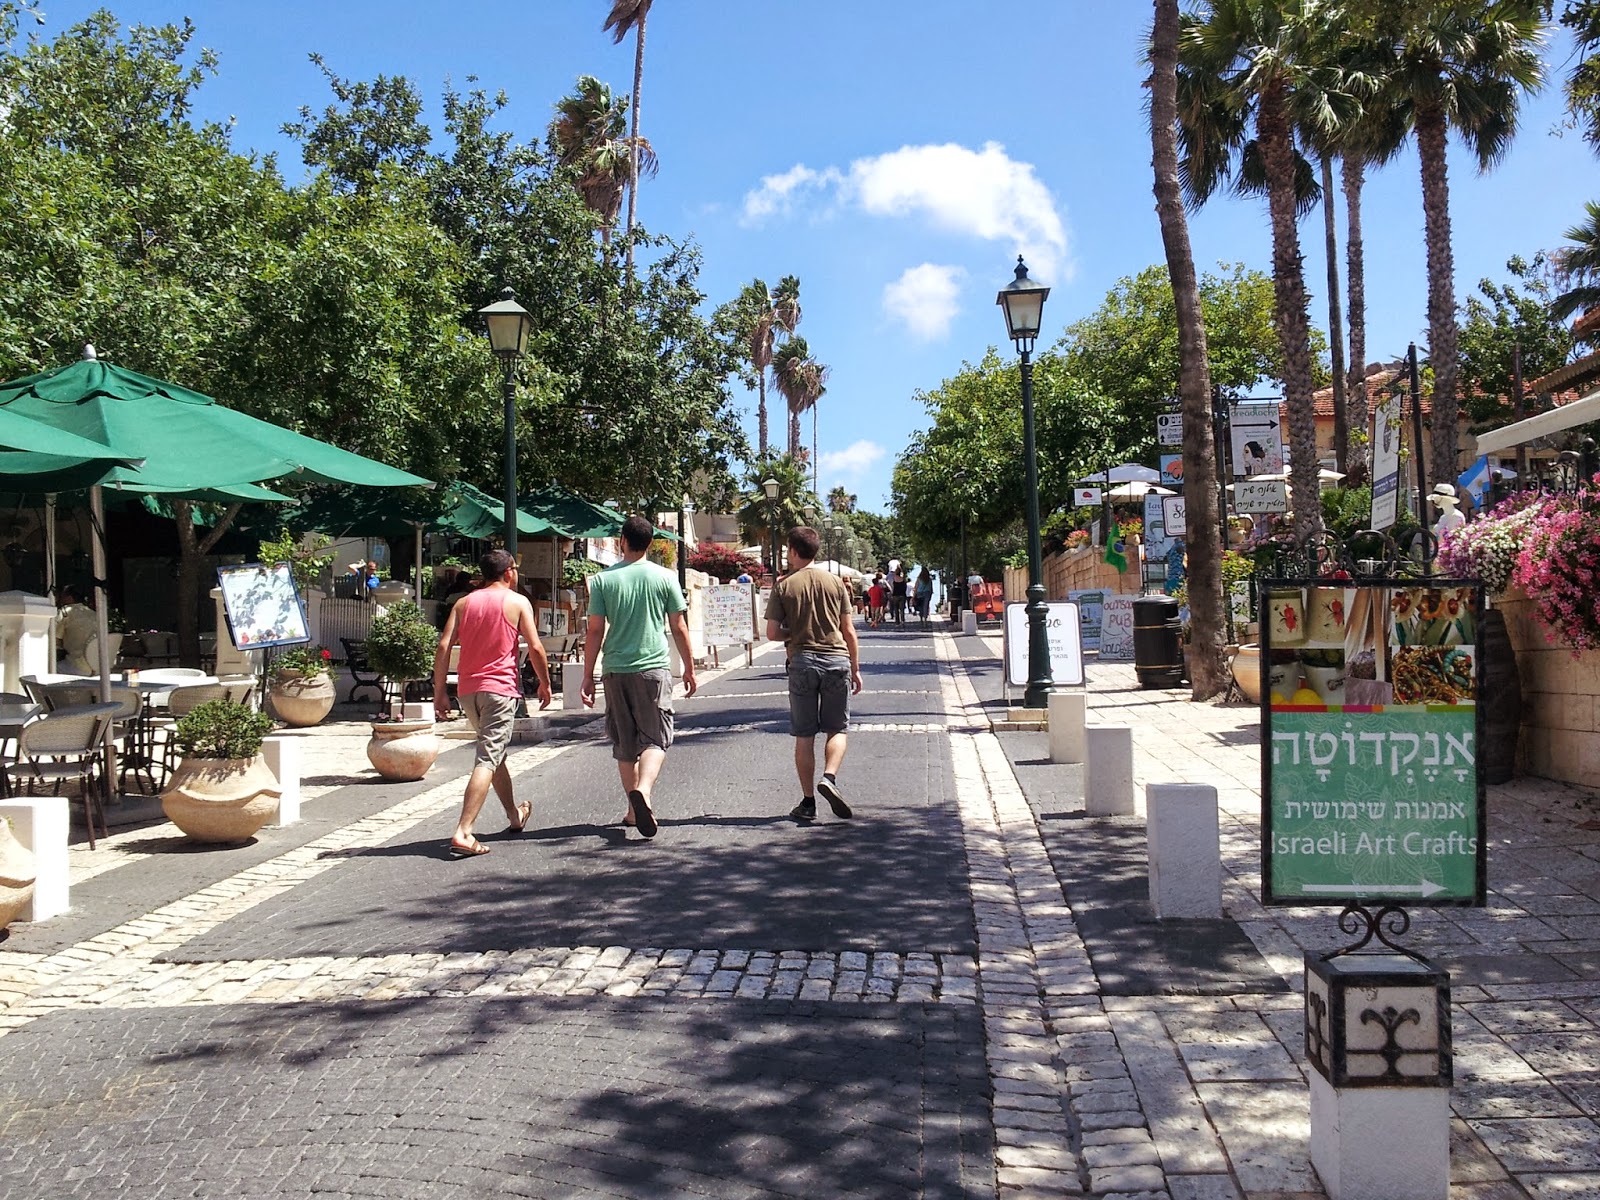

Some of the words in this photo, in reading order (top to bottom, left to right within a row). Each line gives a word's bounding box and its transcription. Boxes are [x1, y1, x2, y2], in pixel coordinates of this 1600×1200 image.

[1108, 613, 1131, 627] PUB
[1284, 800, 1387, 820] שימושית
[1394, 801, 1466, 820] אמנות
[1270, 831, 1347, 856] Israeli
[1354, 831, 1397, 856] Art
[1403, 830, 1478, 856] Crafts
